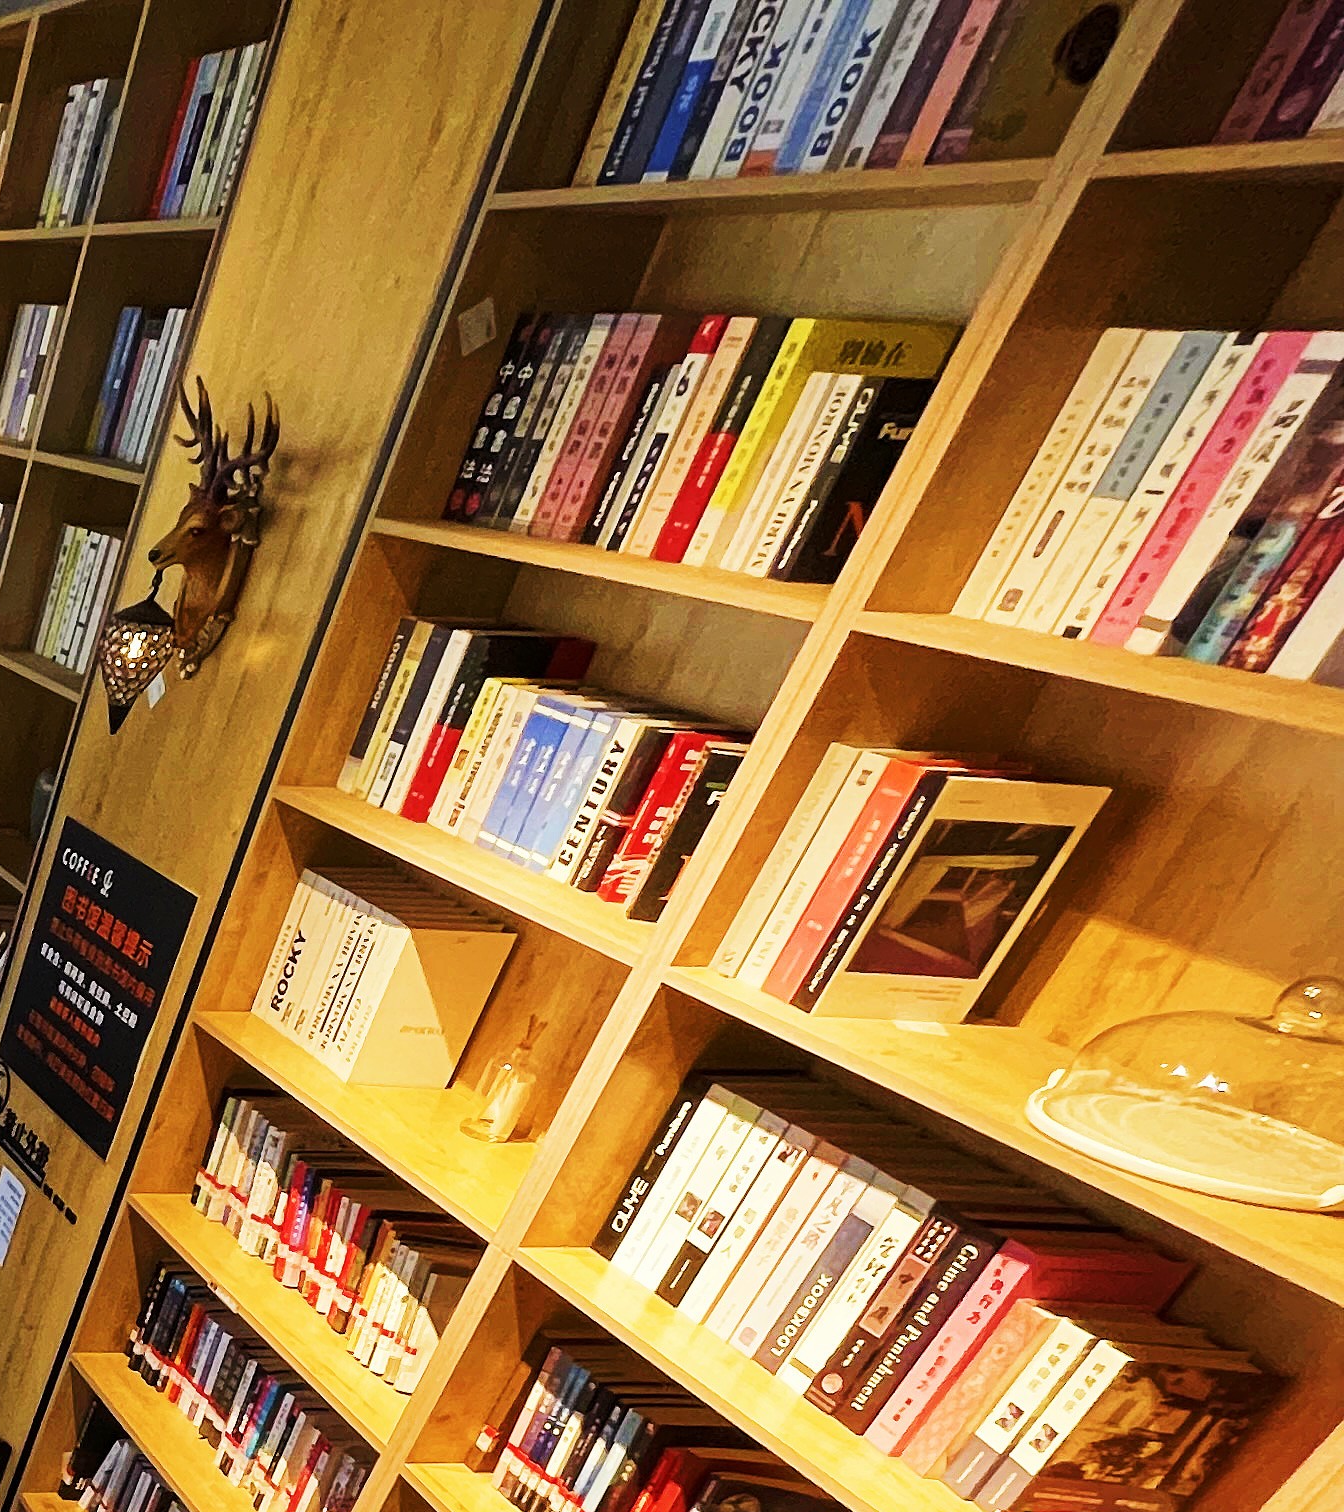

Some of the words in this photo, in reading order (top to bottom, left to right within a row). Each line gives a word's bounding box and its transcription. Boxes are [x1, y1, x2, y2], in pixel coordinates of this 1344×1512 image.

[723, 37, 789, 162] BOOK
[810, 25, 883, 158] BOOK
[558, 739, 625, 867] CENTURY
[62, 847, 100, 886] COFFEE
[270, 929, 307, 1012] ROCKY
[914, 1290, 942, 1326] and
[939, 1244, 980, 1292] Crime
[770, 1273, 833, 1357] LOOKBOOK
[850, 1323, 923, 1412] Punishment
